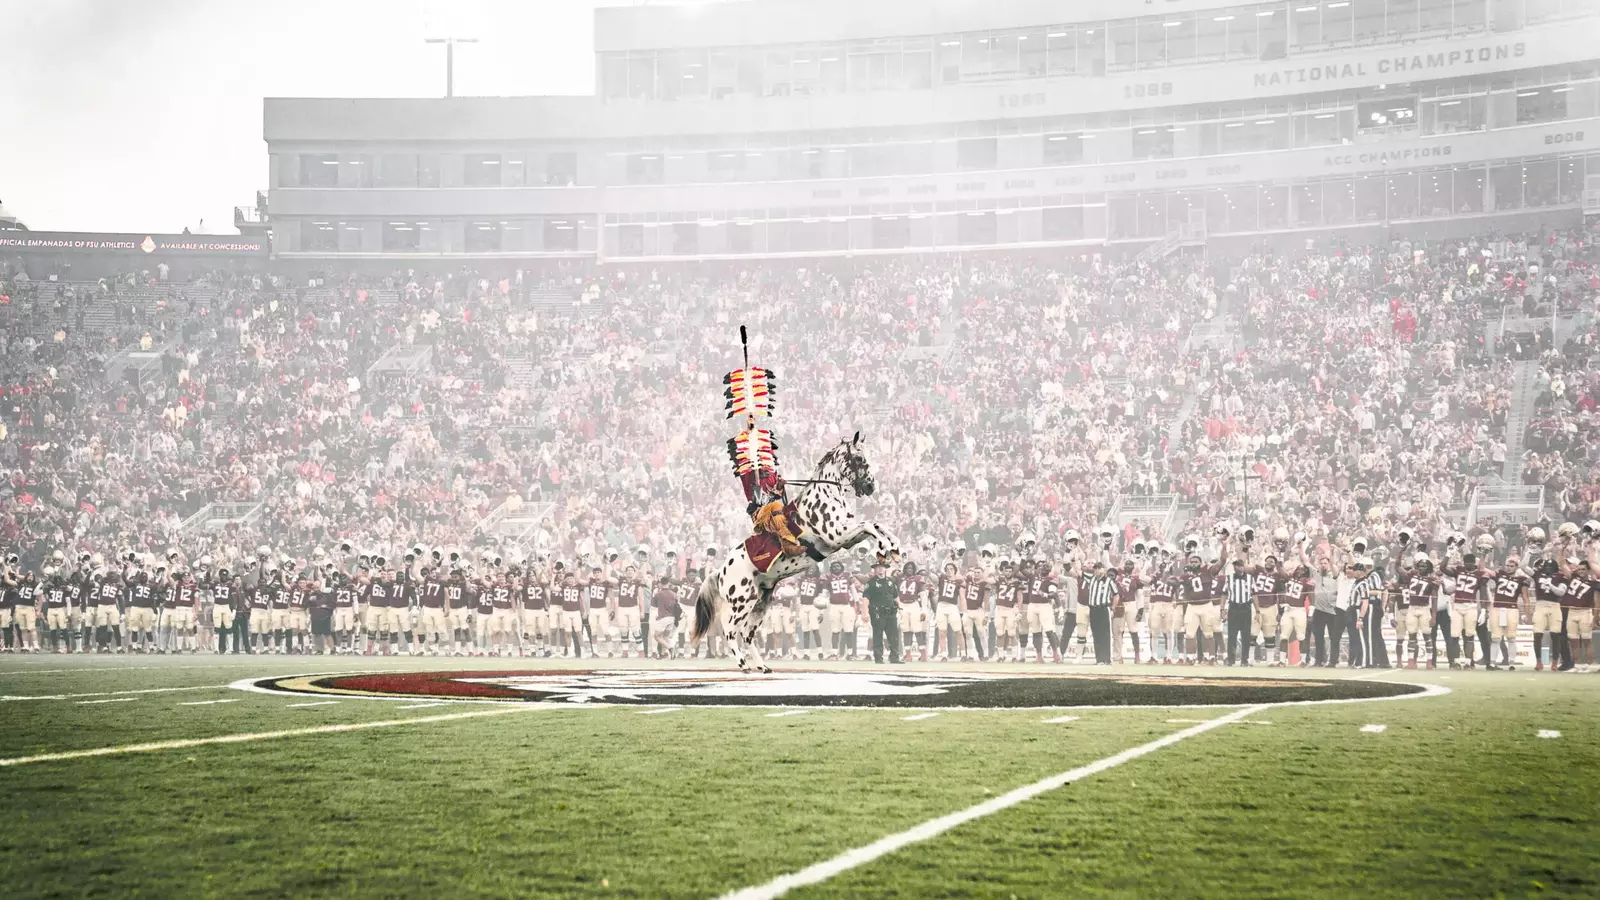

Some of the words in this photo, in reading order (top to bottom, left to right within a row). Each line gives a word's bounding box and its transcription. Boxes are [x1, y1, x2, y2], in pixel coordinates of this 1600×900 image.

[1254, 63, 1367, 87] NATIONAL
[1378, 42, 1526, 74] CHAMPIONS
[1324, 155, 1353, 166] ACC
[1359, 146, 1452, 163] CHAMPIONS
[427, 583, 441, 596] 77
[620, 584, 636, 598] 64
[800, 582, 816, 597] 96
[831, 580, 848, 594] 95
[899, 580, 917, 595] 44
[942, 583, 956, 599] 19
[1192, 577, 1203, 593] 0
[1256, 575, 1276, 593] 55
[1285, 581, 1304, 599] 39
[1409, 578, 1429, 597] 27
[1456, 574, 1478, 594] 52
[1496, 578, 1519, 597] 29
[1567, 578, 1591, 600] 97
[19, 587, 33, 599] 45
[49, 590, 63, 603] 38
[102, 585, 117, 598] 85
[136, 585, 151, 598] 35
[180, 587, 192, 601] 12
[215, 586, 229, 599] 33
[275, 591, 290, 604] 36
[292, 591, 305, 605] 51
[336, 590, 351, 602] 23
[393, 585, 404, 598] 71
[494, 588, 509, 602] 32
[527, 587, 543, 599] 92
[564, 589, 579, 602] 88
[590, 584, 605, 600] 86
[967, 585, 979, 600] 15
[998, 585, 1016, 601] 24
[479, 593, 493, 606] 45
